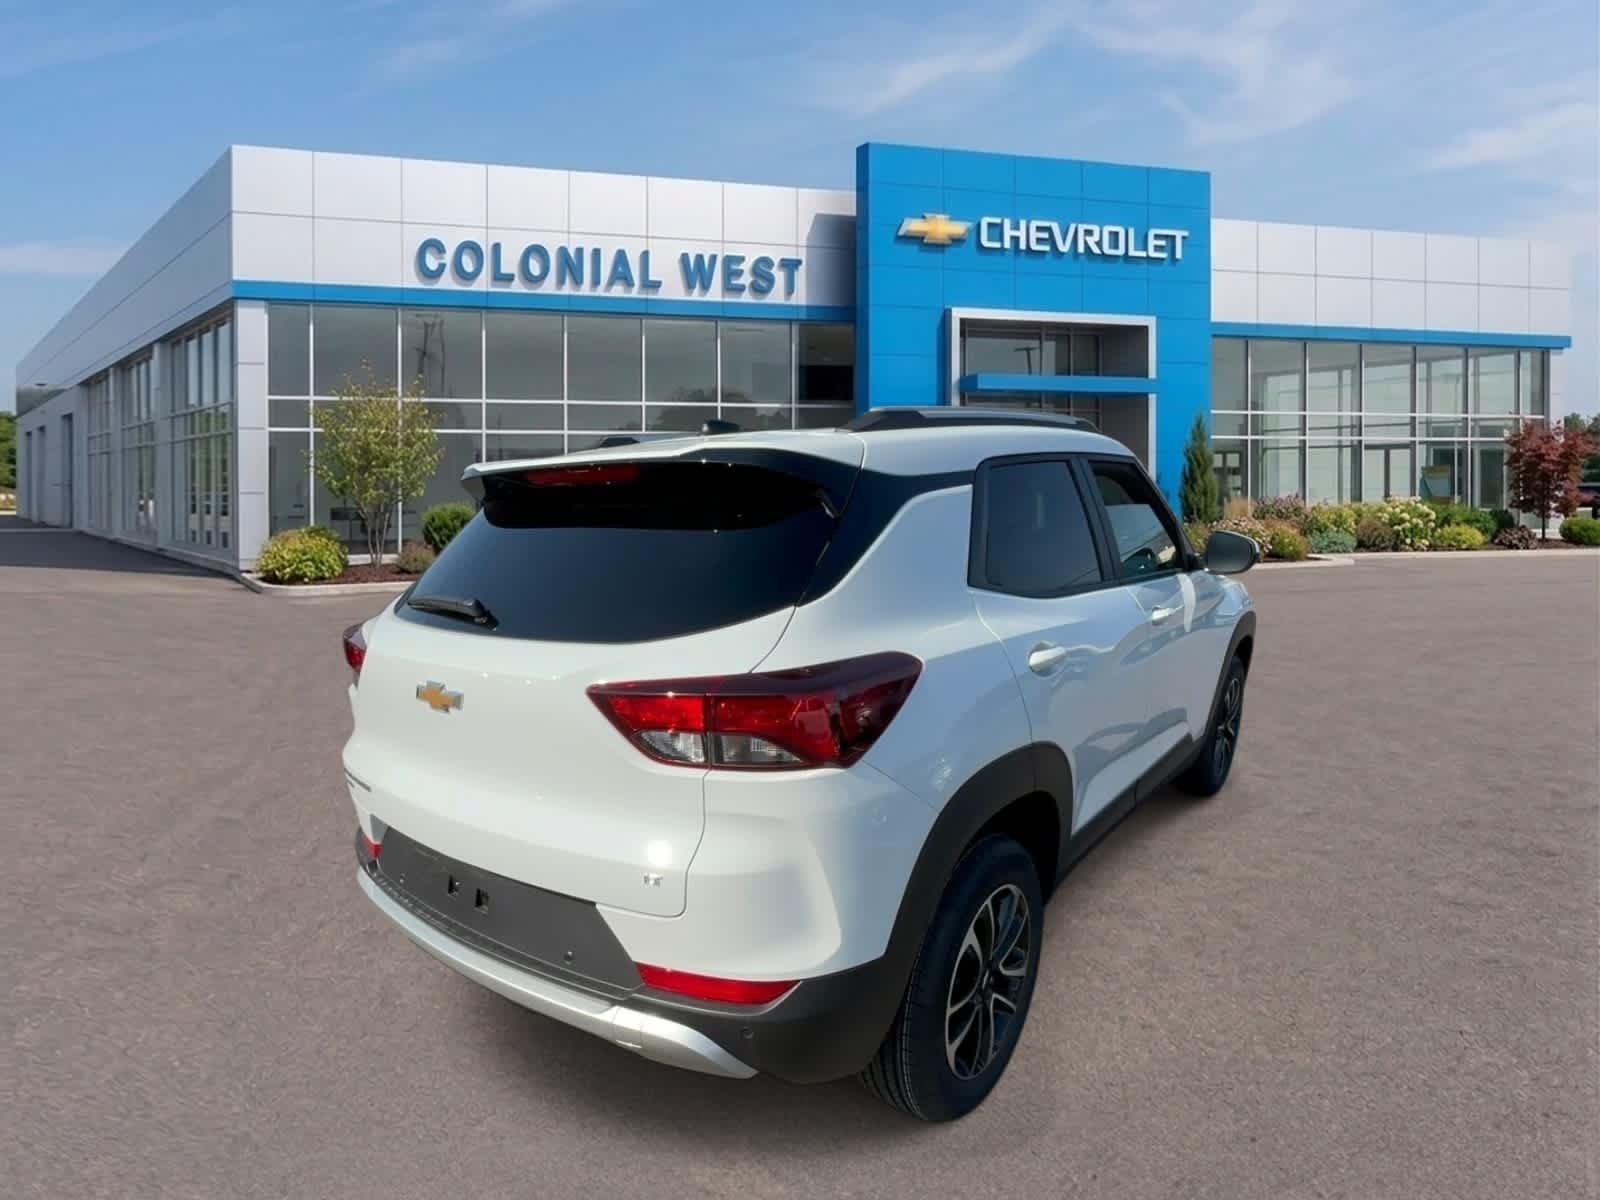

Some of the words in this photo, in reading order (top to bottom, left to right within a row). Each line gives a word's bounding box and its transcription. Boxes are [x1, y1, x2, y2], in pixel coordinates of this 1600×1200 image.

[979, 216, 1189, 260] CHEVROLET
[415, 238, 662, 290] COLONIAL
[680, 251, 803, 299] WEST
